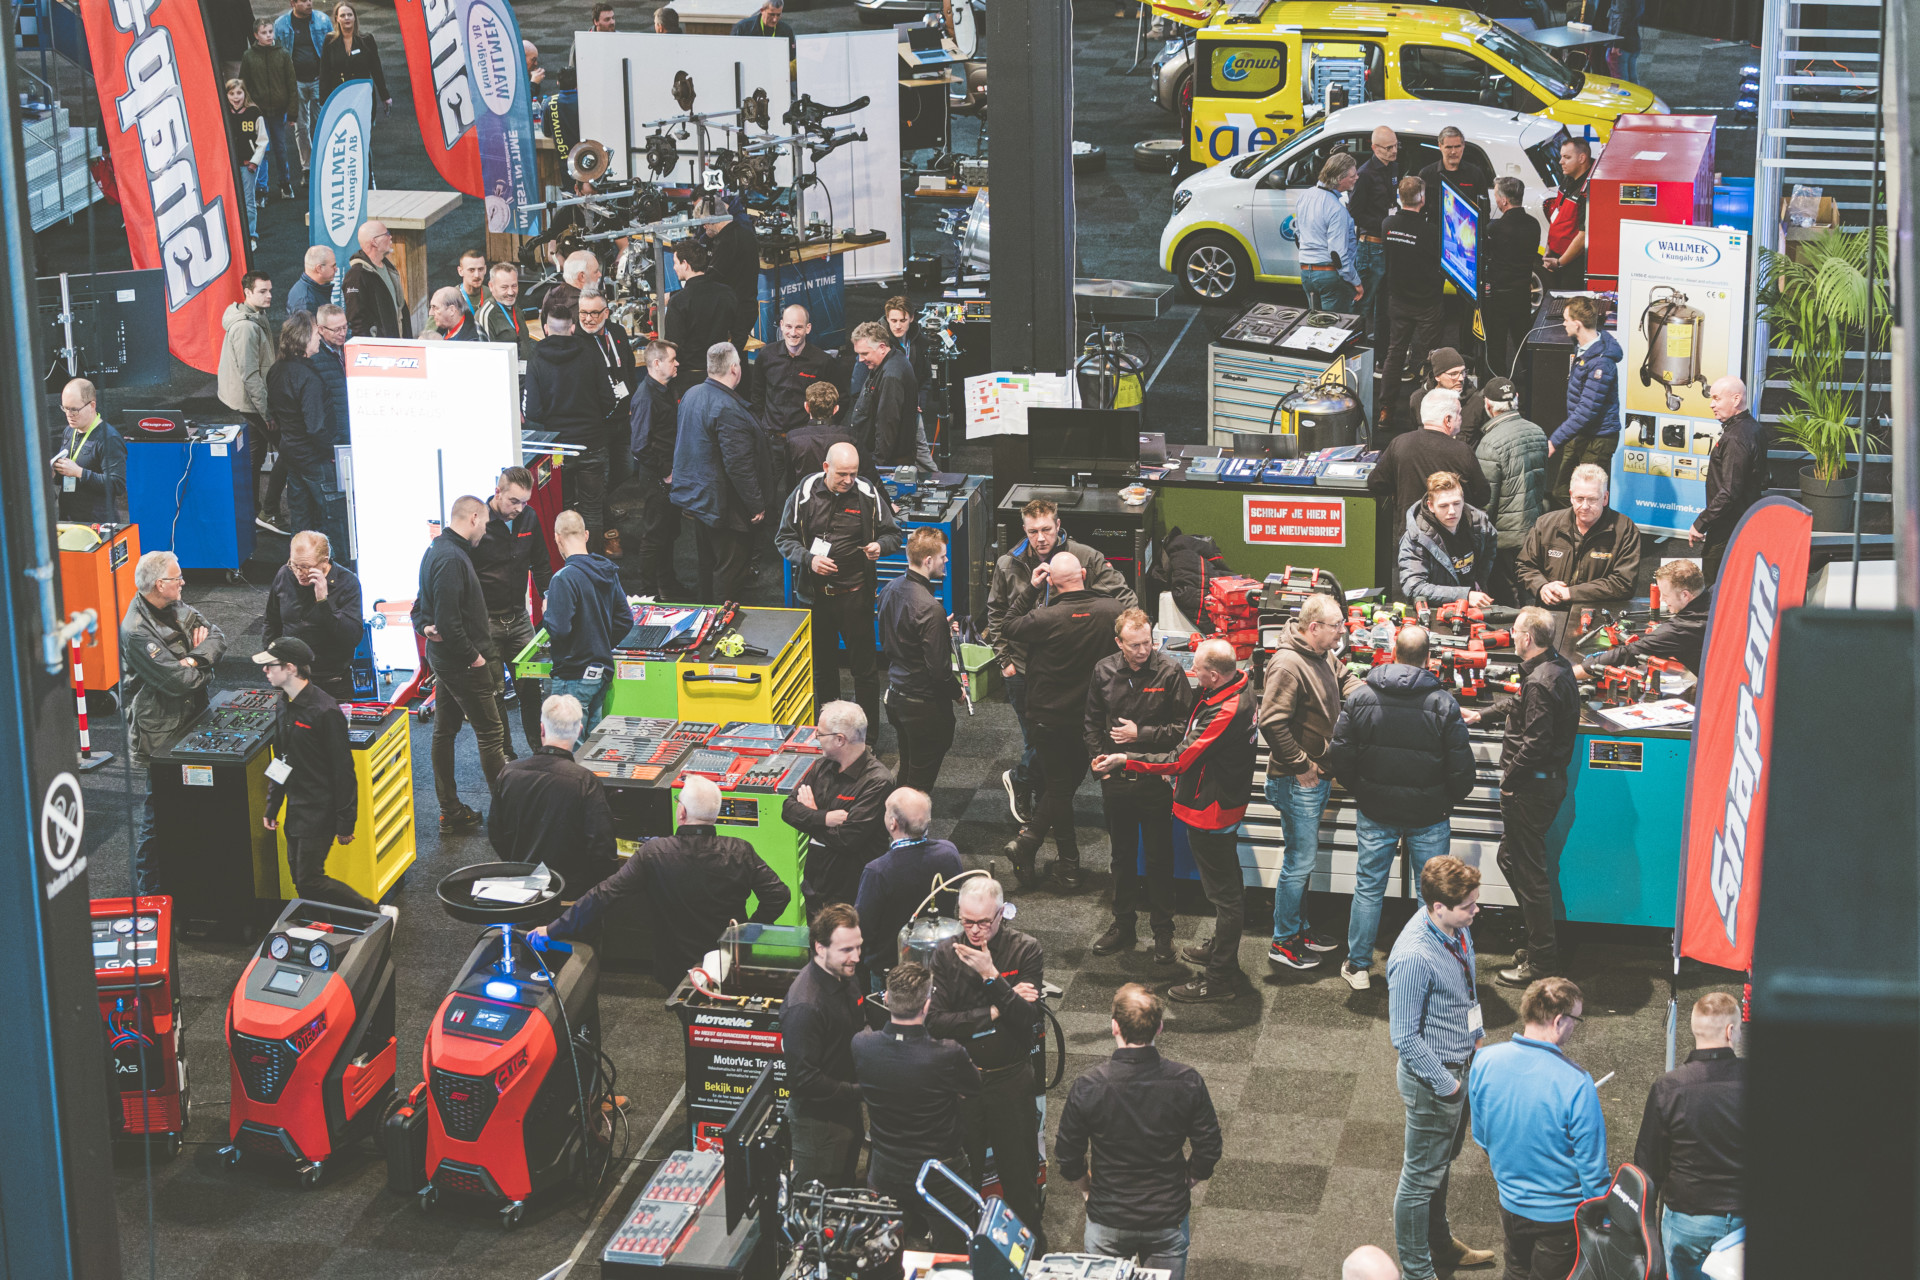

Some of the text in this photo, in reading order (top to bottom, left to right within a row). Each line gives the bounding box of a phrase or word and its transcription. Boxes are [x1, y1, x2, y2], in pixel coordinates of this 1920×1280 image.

[1234, 55, 1280, 69] anwb
[242, 121, 254, 132] 89
[348, 135, 358, 152] AB
[332, 128, 347, 232] WALLMEK
[348, 157, 358, 212] Kungälv
[1658, 240, 1709, 254] WALLMEK
[771, 282, 802, 298] IVEST
[815, 274, 837, 288] TIME
[1251, 507, 1340, 520] SCHRIJF JE HIER IN
[1251, 524, 1340, 537] OP DE NIEUWSBRIEF
[105, 958, 152, 969] GAS
[695, 1014, 753, 1027] MOTORVAC
[713, 1054, 753, 1067] MotorVac
[704, 1081, 731, 1094] Bekijk
[733, 1086, 745, 1094] nu
